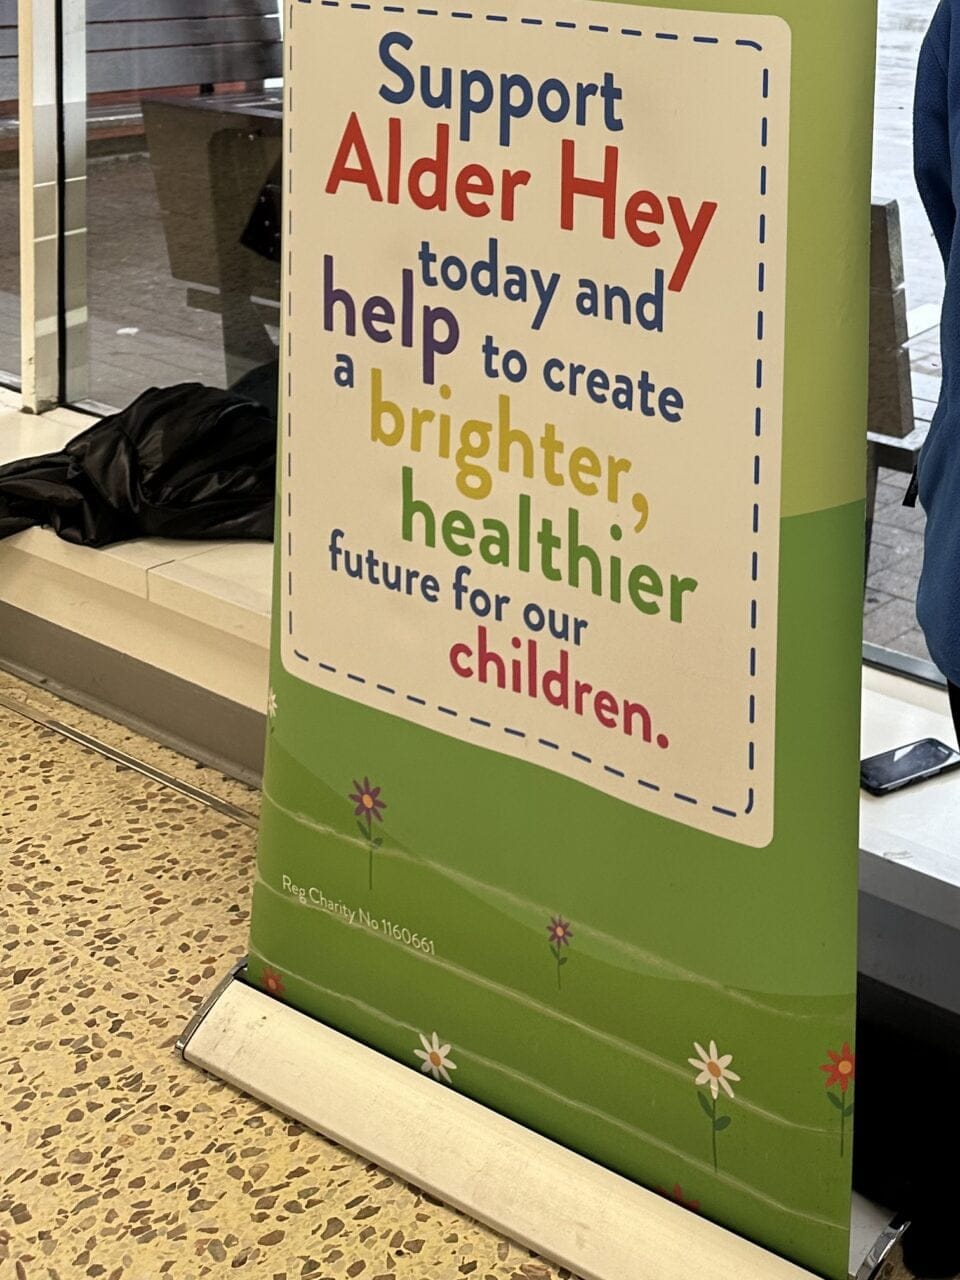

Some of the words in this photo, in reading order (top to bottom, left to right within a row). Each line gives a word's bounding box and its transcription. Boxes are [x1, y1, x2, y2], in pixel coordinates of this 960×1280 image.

[378, 31, 625, 147] Support
[325, 111, 530, 223] Alder
[560, 139, 719, 294] Hey
[322, 255, 461, 385] help
[481, 334, 529, 385] to
[542, 357, 685, 424] create
[418, 240, 561, 331] today
[575, 268, 666, 334] and
[333, 353, 355, 390] a
[370, 369, 650, 534] brighter,
[328, 528, 441, 604] future
[452, 565, 511, 624] for
[522, 601, 589, 648] our
[401, 466, 699, 624] healthier
[449, 626, 671, 751] children.
[282, 874, 307, 905] Reg
[309, 887, 357, 925] Charity
[358, 907, 380, 930] No
[381, 918, 436, 956] 1160661
